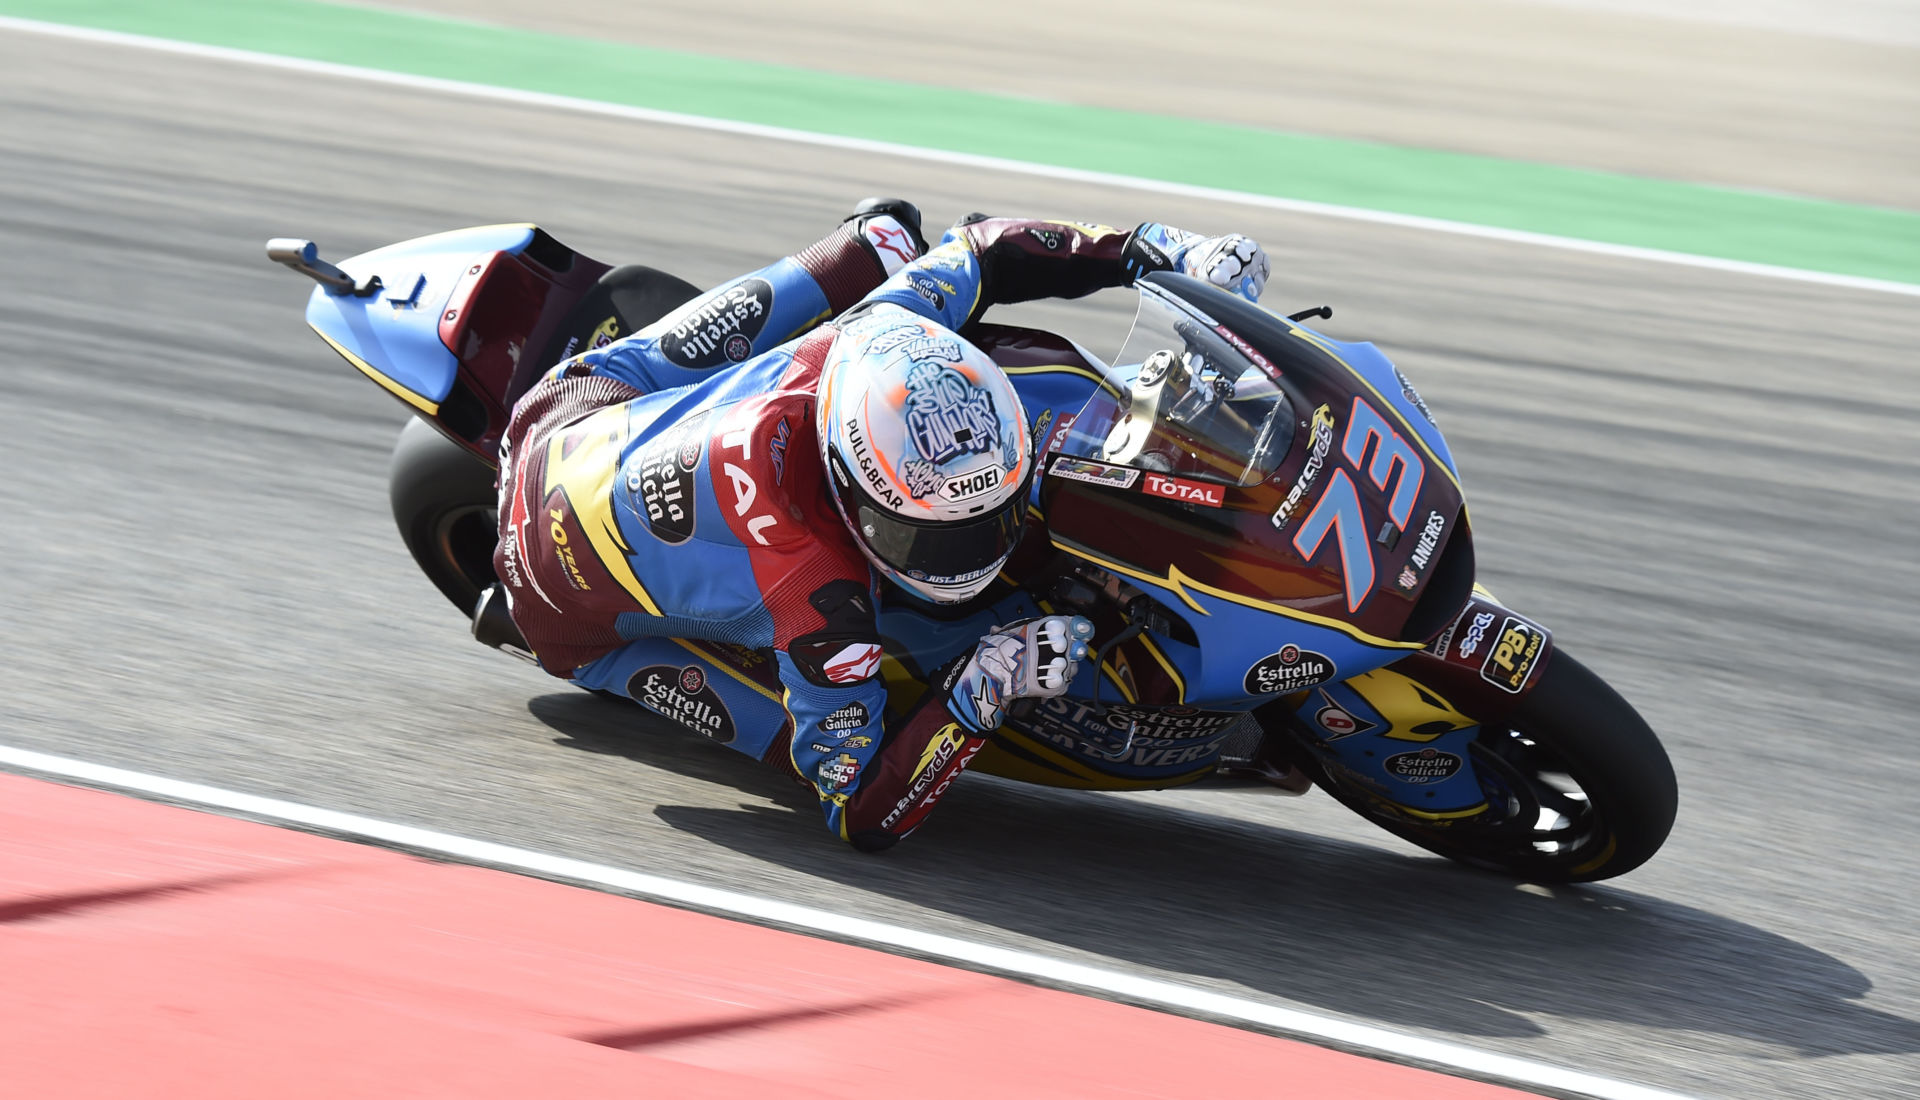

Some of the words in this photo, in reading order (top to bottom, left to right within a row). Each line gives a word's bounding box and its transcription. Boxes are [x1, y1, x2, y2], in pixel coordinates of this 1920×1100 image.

[671, 286, 748, 340] Galicia
[681, 294, 764, 360] Estrella
[846, 418, 904, 511] PULL&BEAR
[947, 468, 999, 499] SHOEI
[1148, 476, 1219, 504] TOTAL
[1291, 396, 1426, 614] 73
[551, 508, 568, 546] 10
[562, 545, 592, 592] YEARS
[1411, 510, 1445, 570] ANIÈRES
[928, 574, 952, 584] JUST
[953, 569, 980, 583] BEER
[1493, 628, 1528, 672] PB
[1256, 661, 1325, 682] Estrella
[1259, 676, 1320, 693] Galicia
[642, 673, 722, 729] Estrella
[643, 694, 714, 738] Galicia
[1108, 705, 1233, 728] Estrella
[825, 717, 862, 730] Galicia
[833, 764, 856, 774] ara
[919, 739, 986, 808] TOTAL
[1396, 765, 1448, 776] Galicia
[1397, 756, 1453, 768] Estrella
